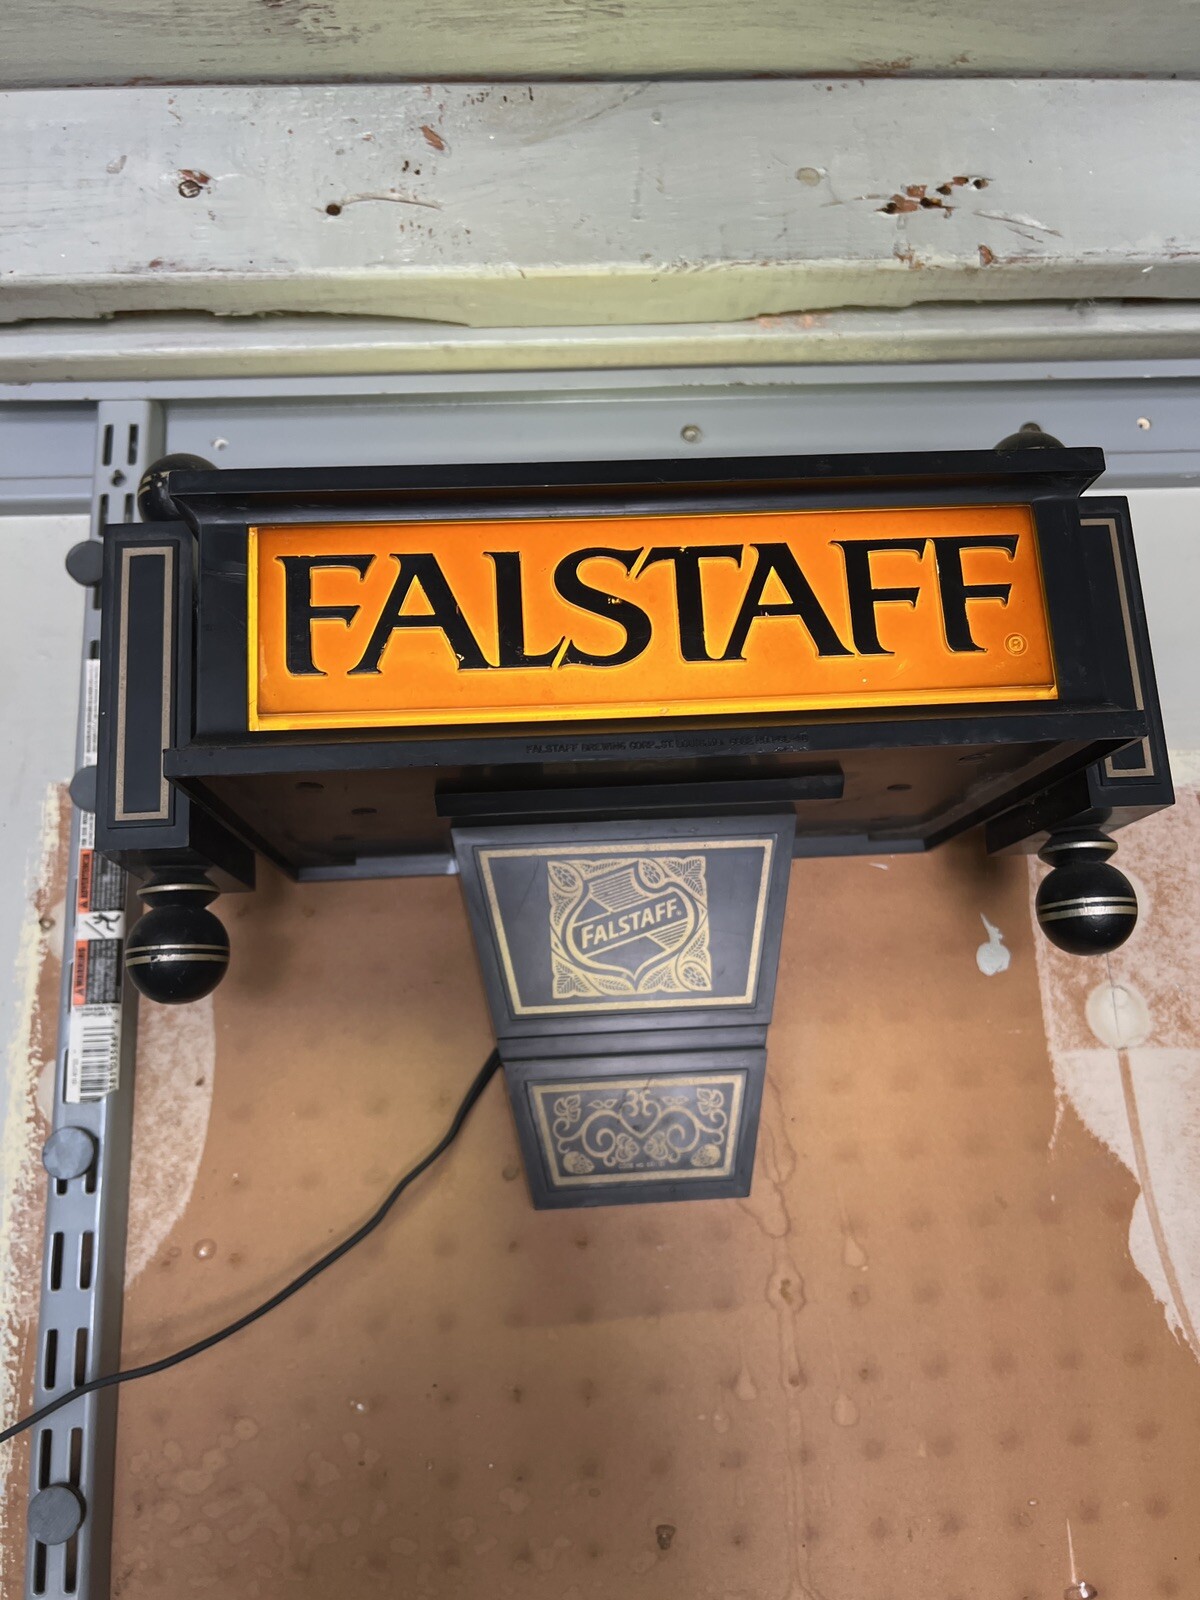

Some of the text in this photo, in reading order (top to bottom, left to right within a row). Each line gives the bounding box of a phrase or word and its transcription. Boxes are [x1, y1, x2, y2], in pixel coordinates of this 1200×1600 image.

[276, 534, 1020, 678] FALSTAFF
[525, 742, 578, 755] FALSTAFF
[580, 898, 678, 949] FALSTAFF
